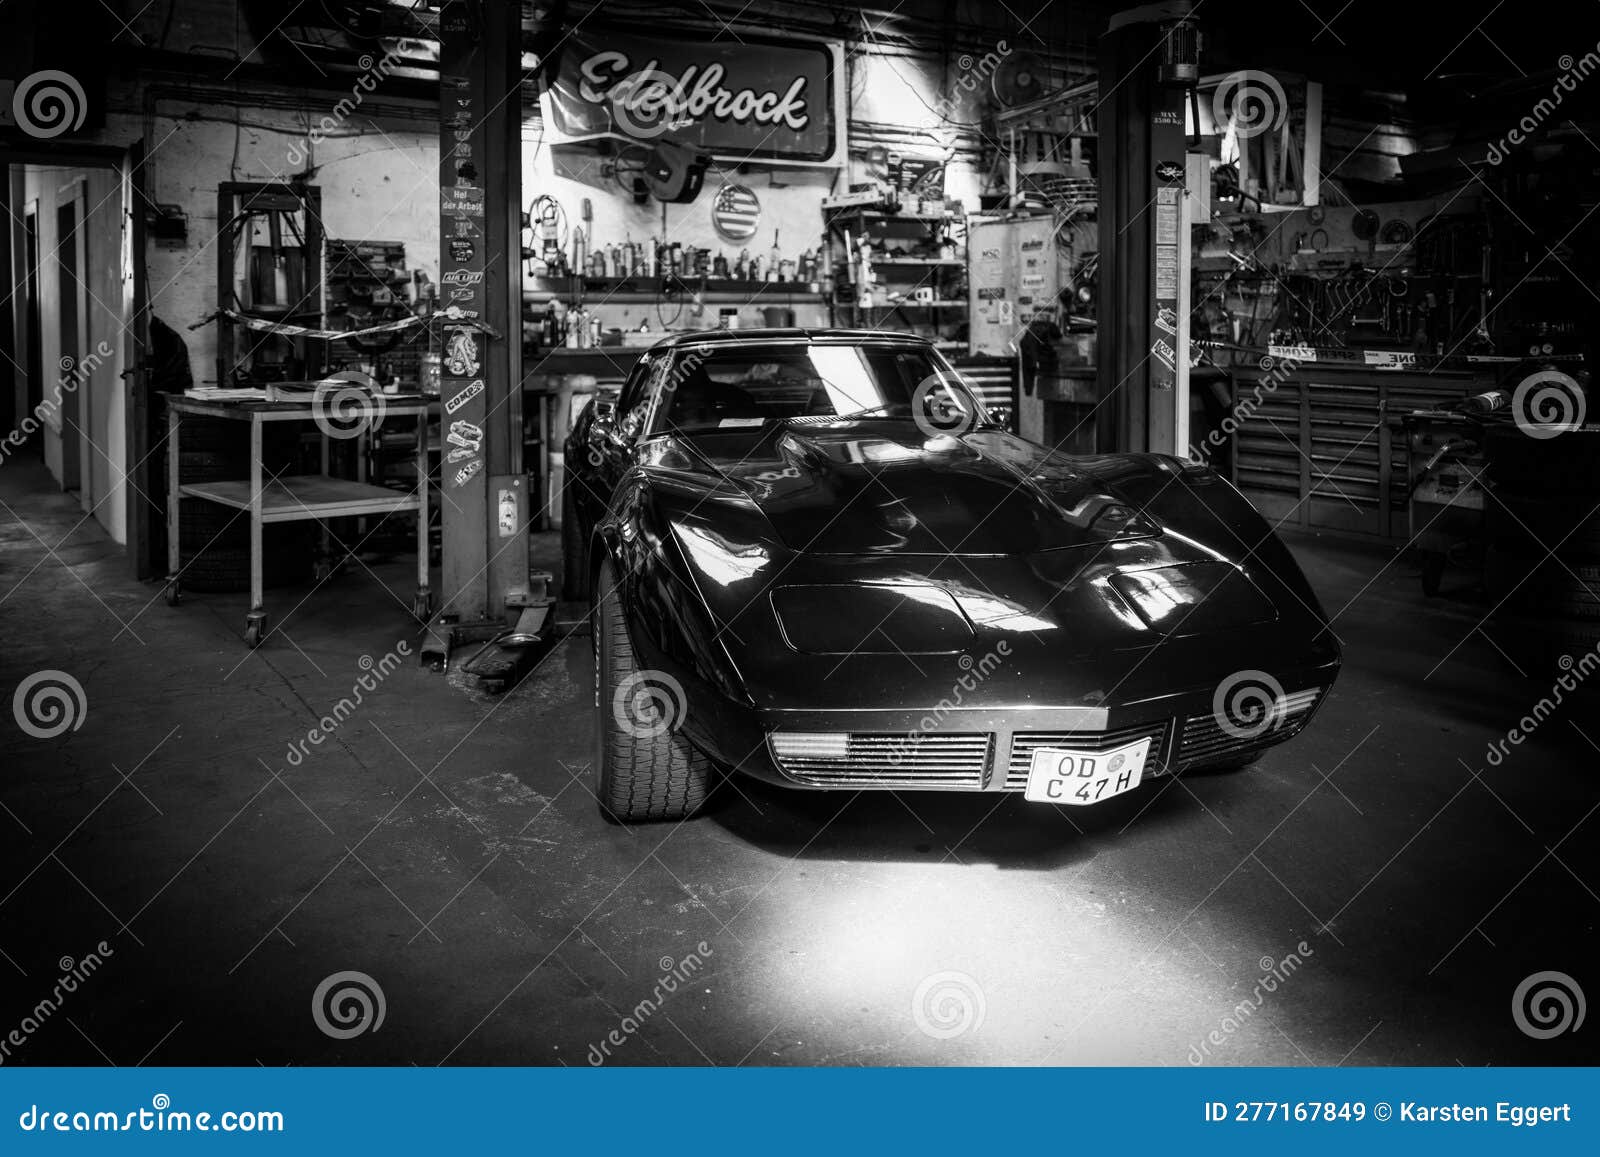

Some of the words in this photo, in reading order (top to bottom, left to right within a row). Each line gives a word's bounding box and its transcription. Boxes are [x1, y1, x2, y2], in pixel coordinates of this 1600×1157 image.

[580, 51, 808, 129] Edelbrock
[1058, 756, 1096, 778] OD
[1047, 779, 1063, 798] C
